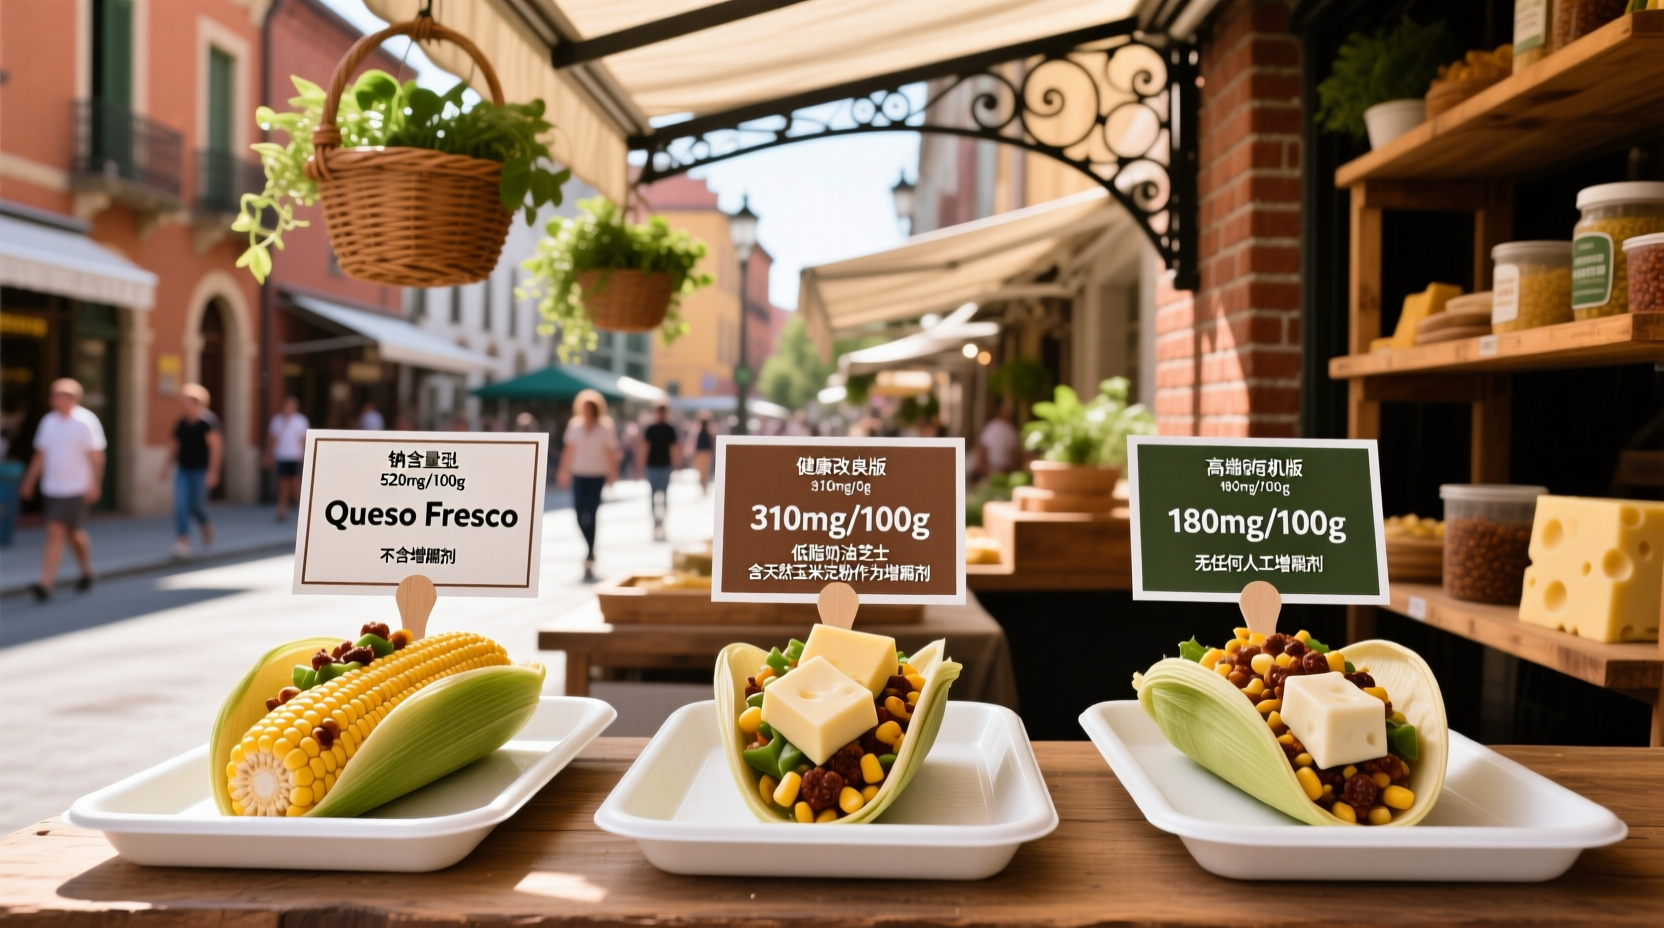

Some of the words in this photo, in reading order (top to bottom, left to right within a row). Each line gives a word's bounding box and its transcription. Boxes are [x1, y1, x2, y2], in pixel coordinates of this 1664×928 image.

[796, 456, 887, 476] 健康改良版
[325, 500, 416, 531] Queso
[425, 501, 519, 528] Fresco
[750, 504, 931, 540] 310mg/100g
[1168, 507, 1347, 544] 180mg/100g
